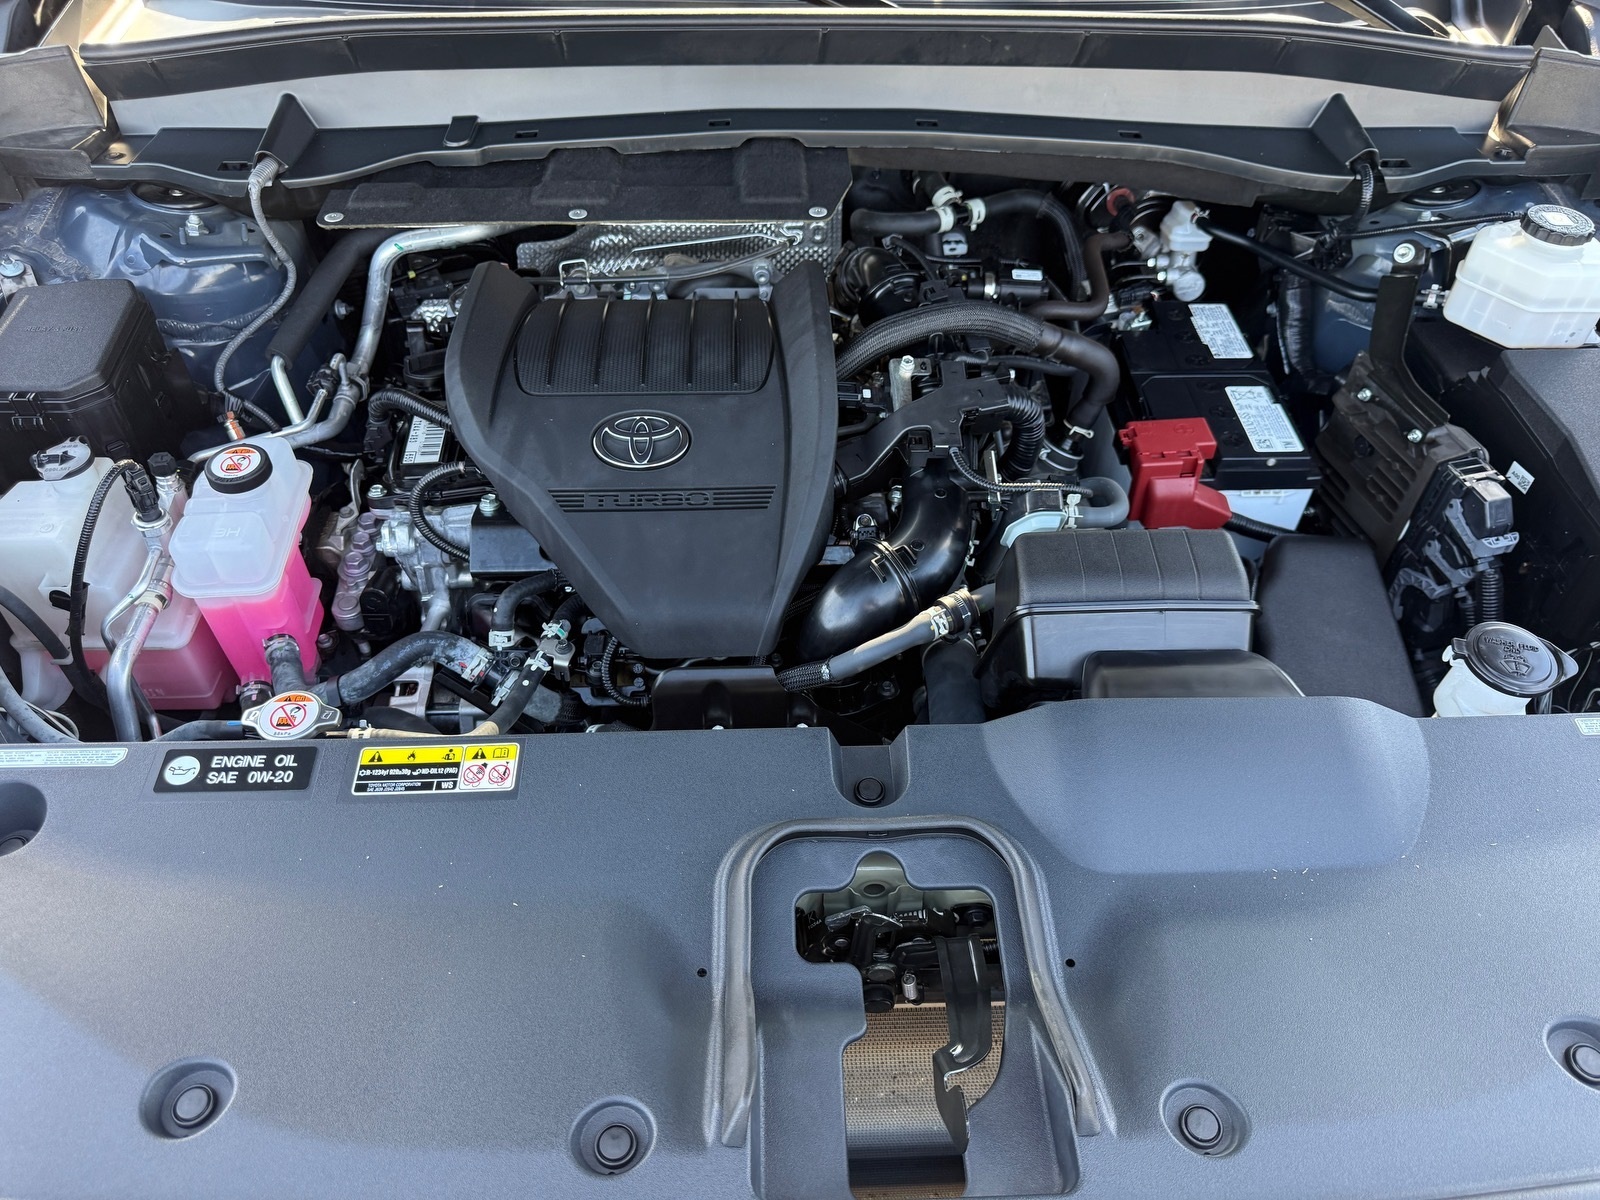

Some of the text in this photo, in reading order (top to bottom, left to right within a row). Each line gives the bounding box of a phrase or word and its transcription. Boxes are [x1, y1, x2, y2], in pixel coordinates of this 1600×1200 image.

[587, 491, 711, 507] TURBO
[210, 754, 298, 768] ENGINE OIL
[206, 770, 294, 784] SAE 0W-20
[441, 781, 454, 789] WS
